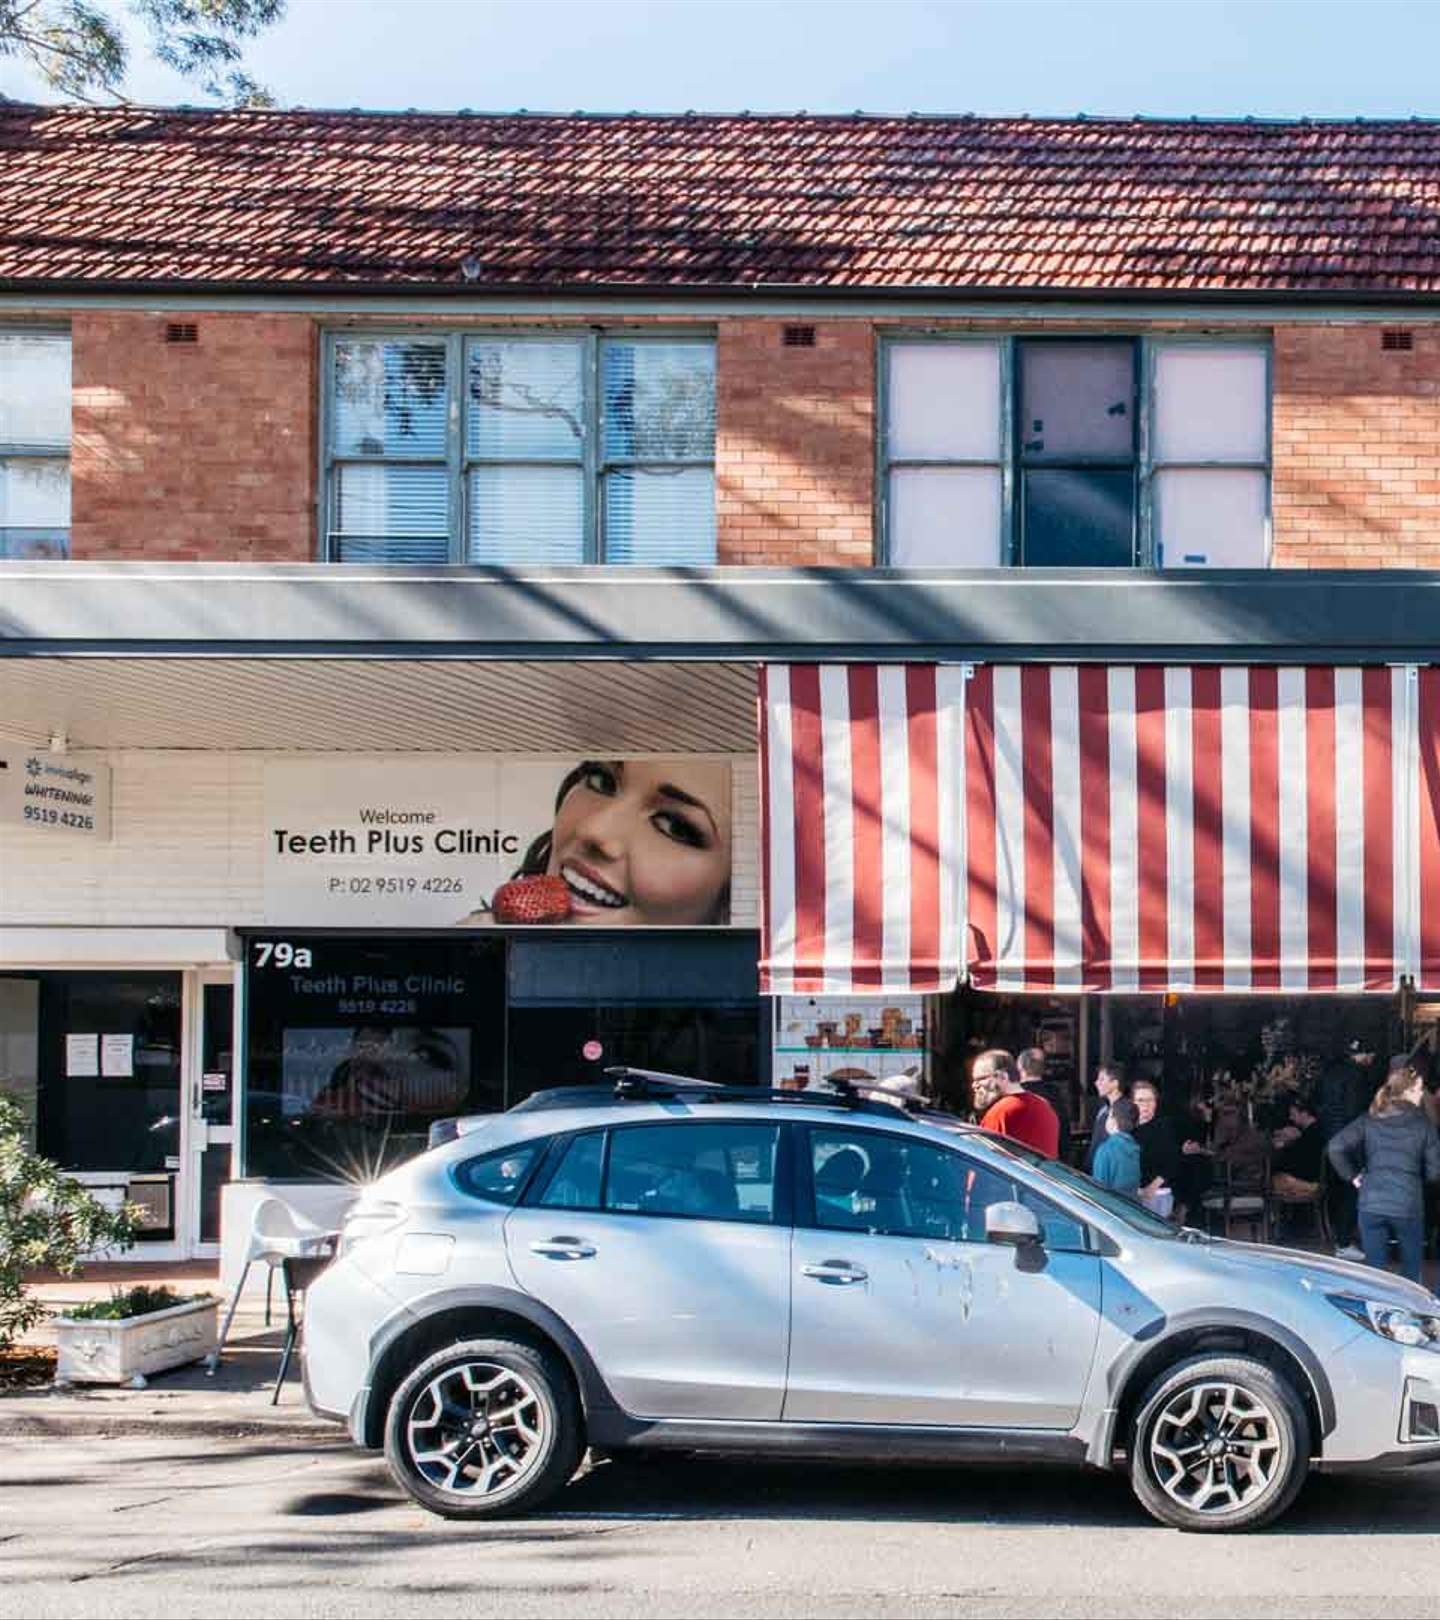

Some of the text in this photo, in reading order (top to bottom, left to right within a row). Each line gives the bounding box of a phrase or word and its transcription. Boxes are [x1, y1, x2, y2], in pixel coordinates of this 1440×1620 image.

[23, 805, 94, 830] 9519 4226
[359, 808, 436, 825] Welcome
[273, 829, 519, 854] Teeth Plus Clinic
[329, 877, 463, 894] P: 02 9519 4226
[254, 942, 312, 968] 79a
[290, 974, 466, 994] Teeth Plus Clinic
